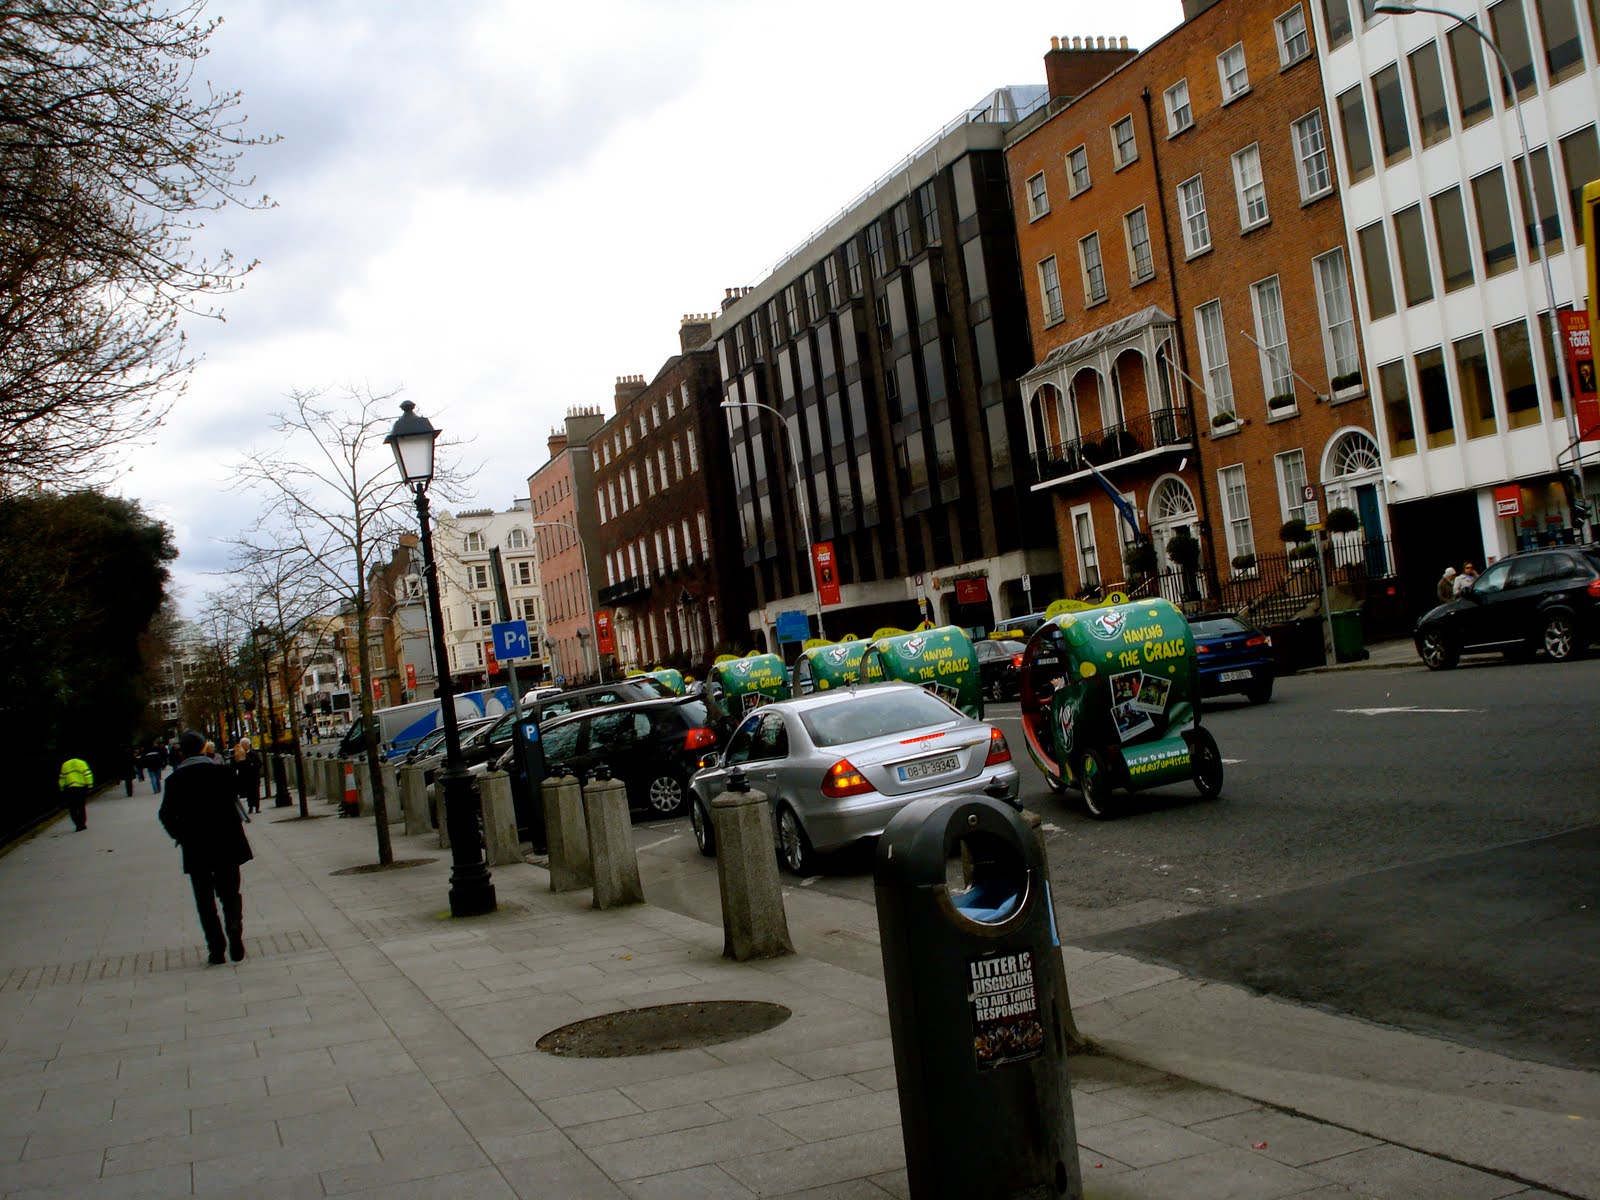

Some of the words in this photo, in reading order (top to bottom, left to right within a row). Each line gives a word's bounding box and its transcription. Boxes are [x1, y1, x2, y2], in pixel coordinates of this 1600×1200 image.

[1568, 336, 1591, 347] TOUR
[504, 631, 517, 650] P
[1123, 624, 1163, 644] HAVING
[922, 647, 953, 662] HAVING
[1118, 649, 1140, 668] THE
[1143, 639, 1186, 662] CRAIC
[919, 666, 935, 680] THE
[937, 657, 970, 676] CRAIC
[526, 725, 535, 739] P
[907, 758, 956, 777] 08-D-39343
[970, 955, 1017, 979] LITTER
[972, 969, 1033, 994] DISGUSTING
[975, 997, 989, 1010] SO
[990, 993, 1009, 1007] ARE
[1009, 987, 1035, 1003] THOSE
[976, 998, 1037, 1022] RESPONSIBLE
